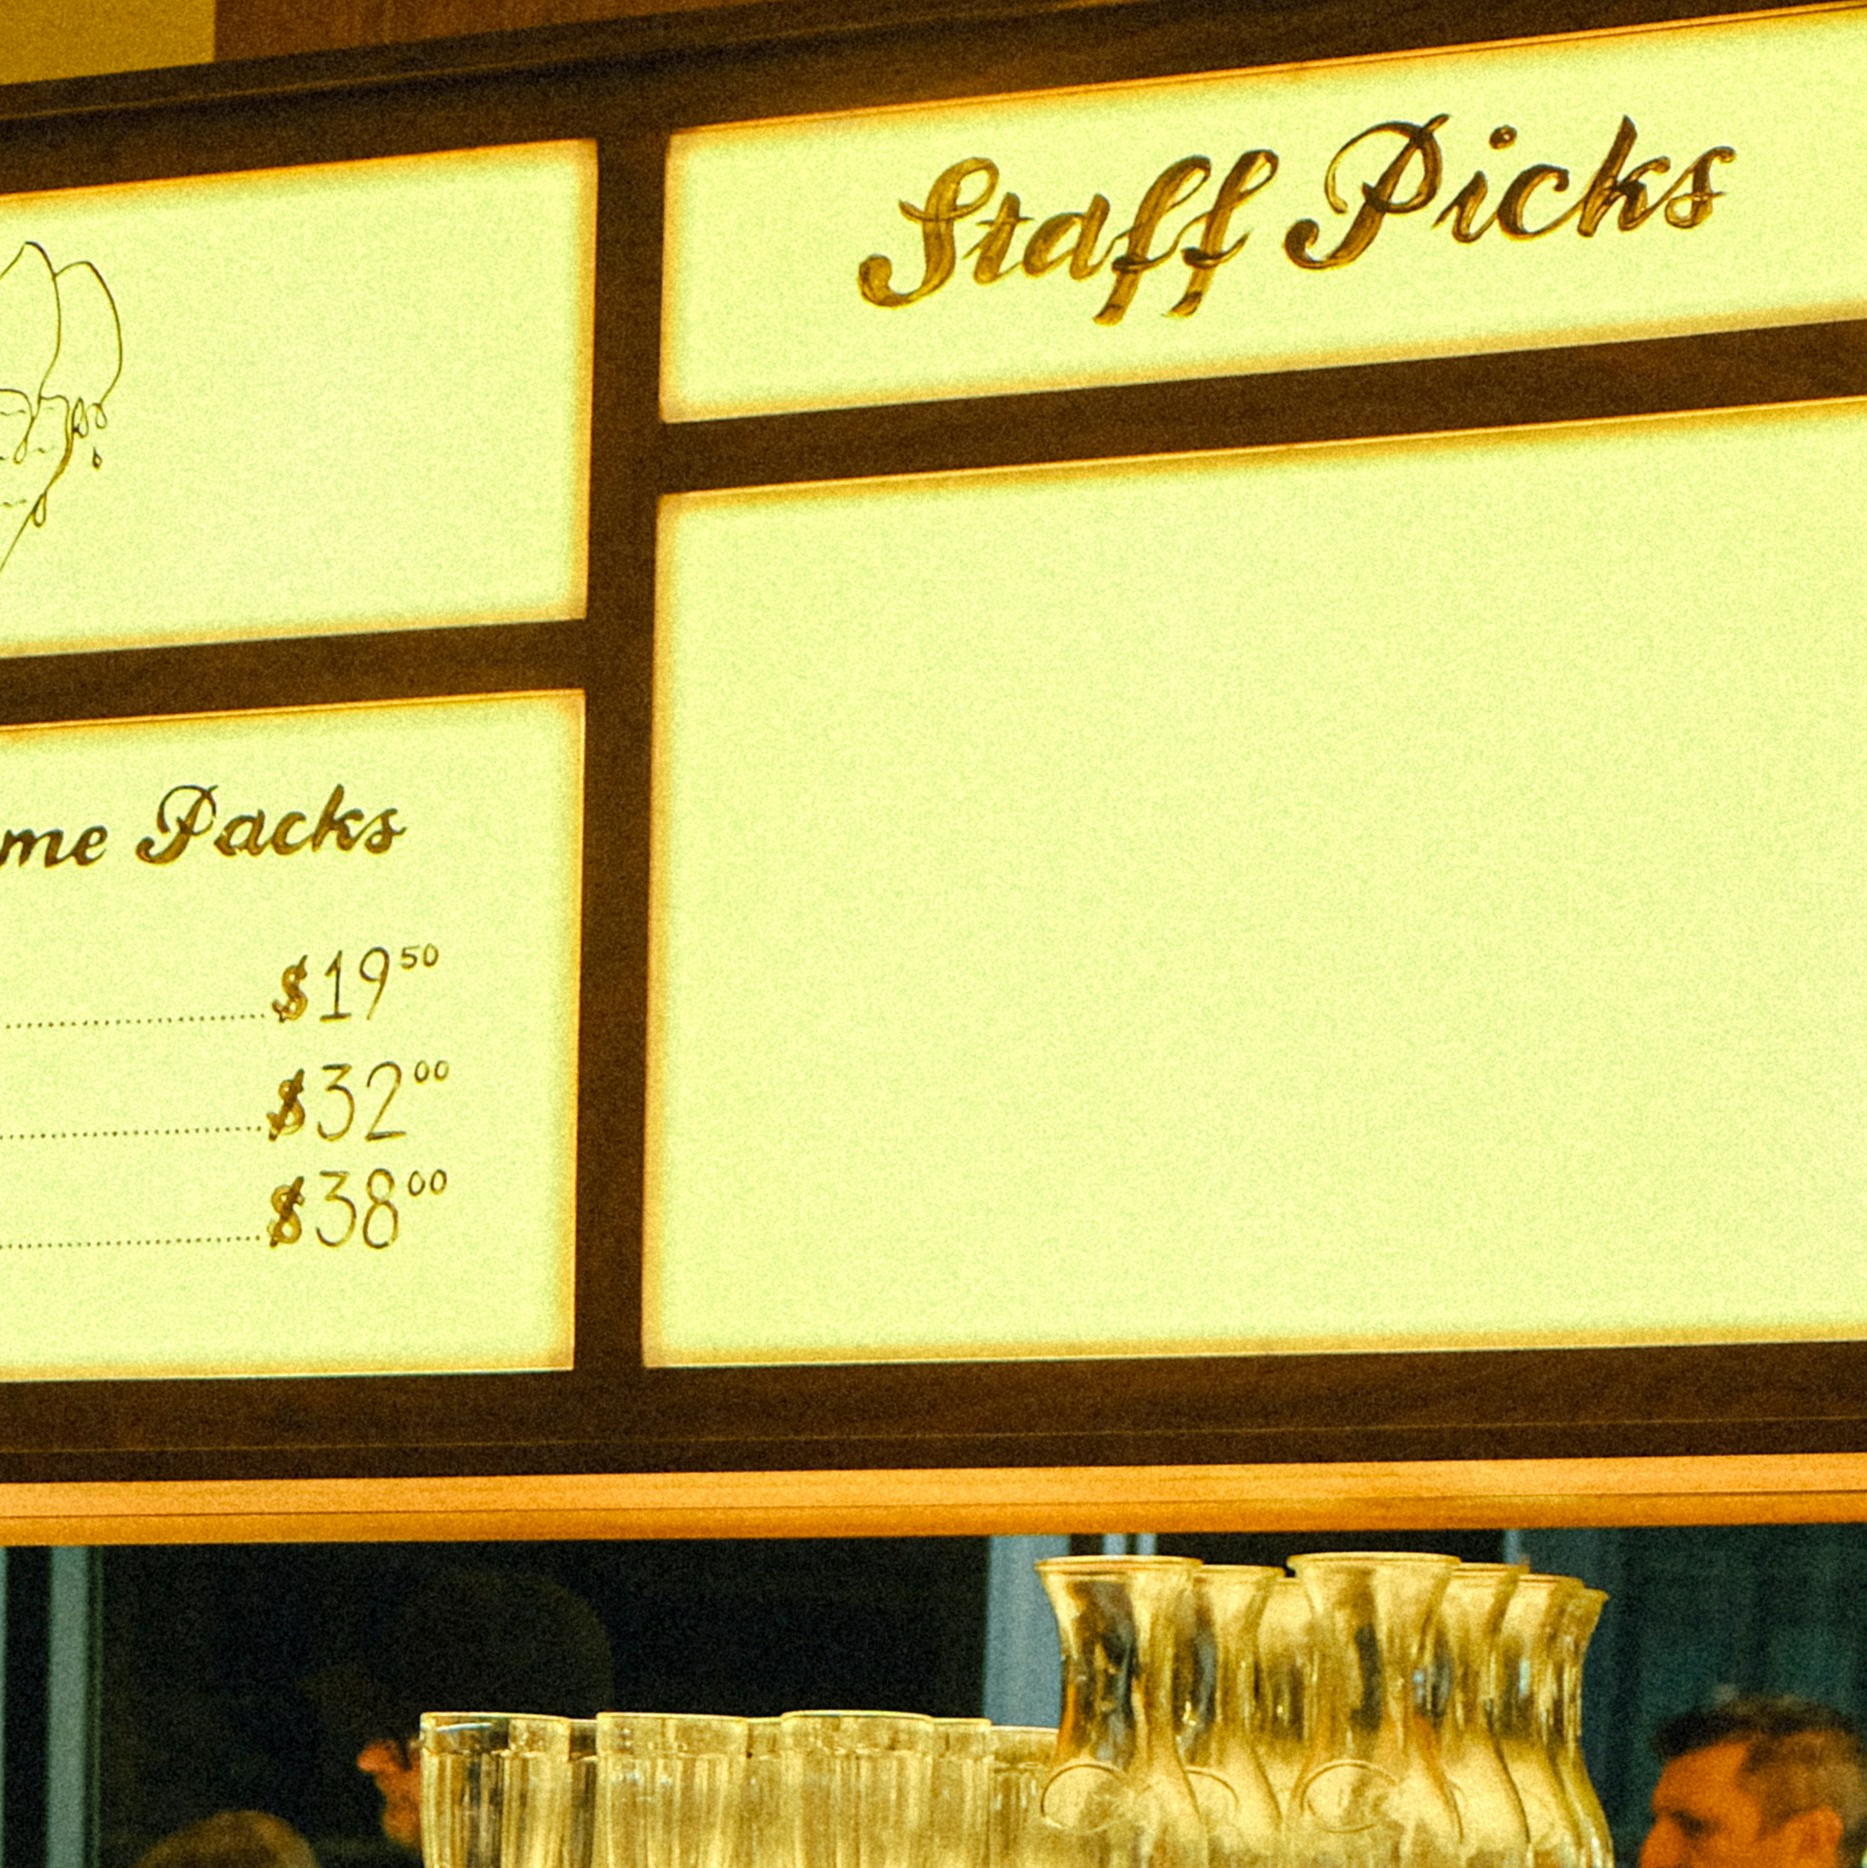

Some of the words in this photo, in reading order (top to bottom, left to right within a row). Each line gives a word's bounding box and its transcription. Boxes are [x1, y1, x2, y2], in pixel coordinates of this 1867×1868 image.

[858, 149, 1281, 324] Staff
[1286, 112, 1738, 272] Picks
[136, 784, 406, 864] Packs
